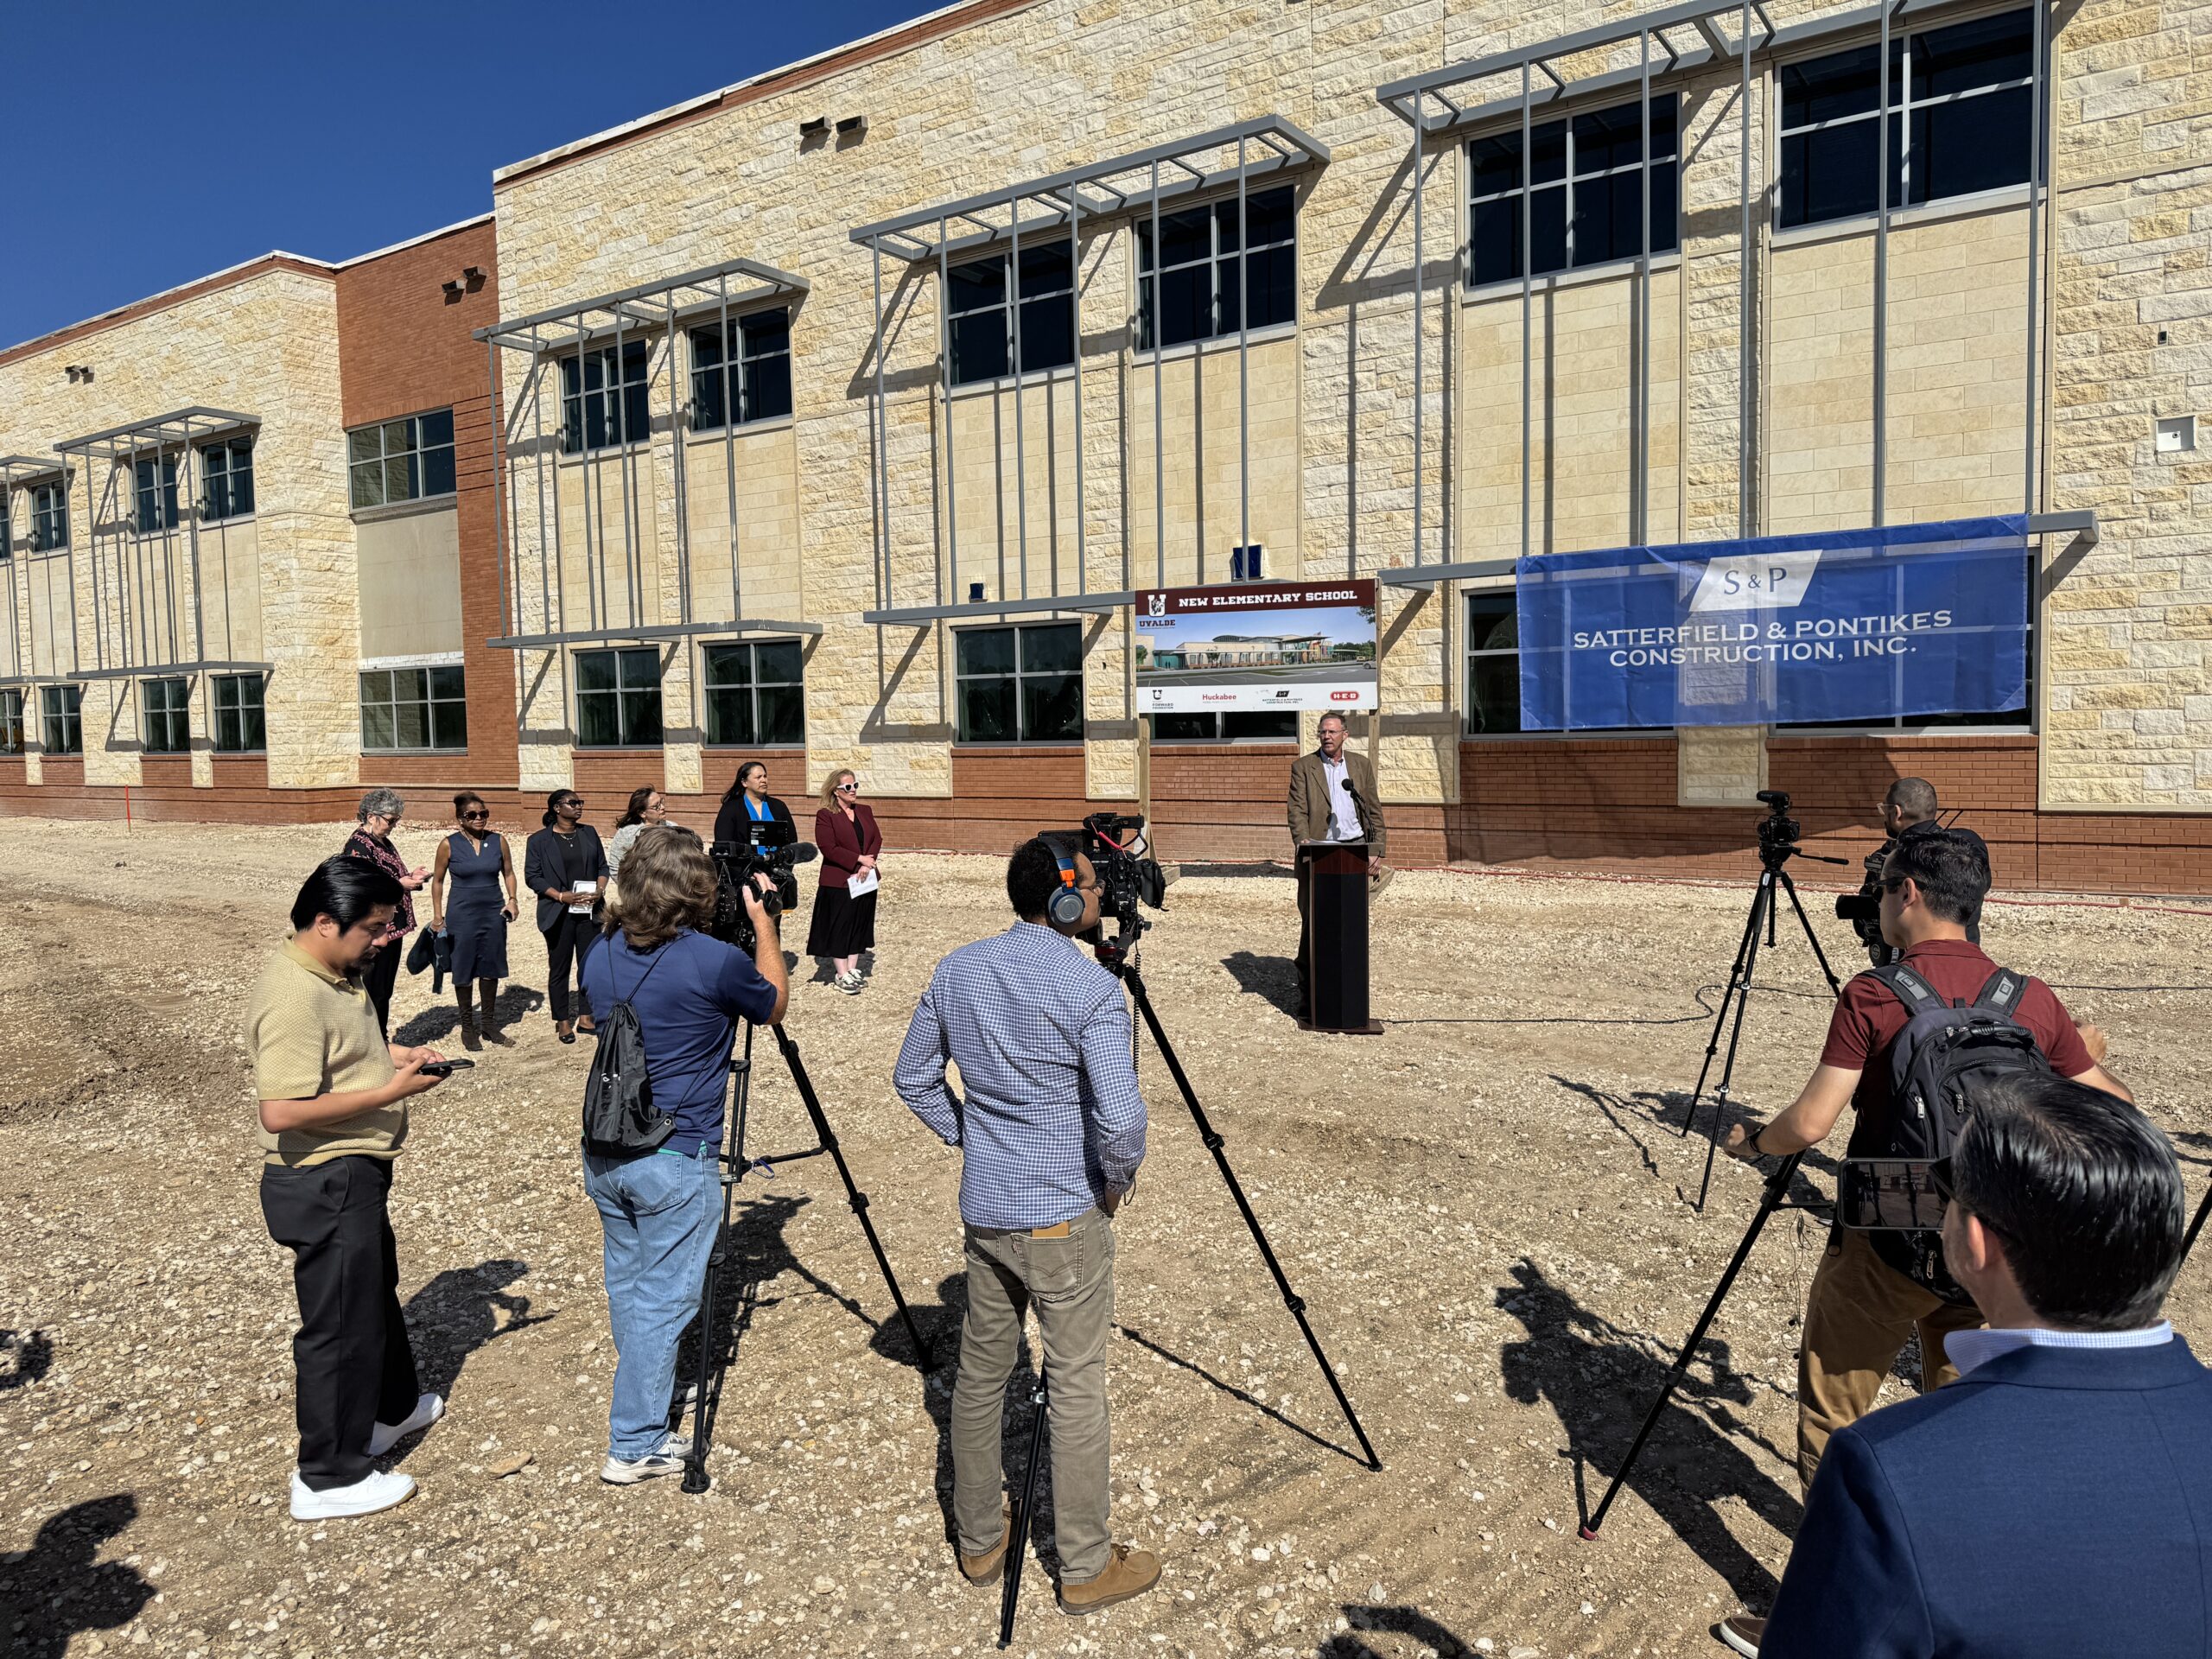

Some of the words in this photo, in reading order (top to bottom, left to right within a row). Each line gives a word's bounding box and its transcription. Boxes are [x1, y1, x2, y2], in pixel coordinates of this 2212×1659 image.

[1179, 597, 1208, 607] NEW
[1212, 593, 1301, 606] ELEMENTARY
[1306, 590, 1357, 601] SCHOOL
[1573, 622, 1758, 648] SATTERFIELD
[1767, 621, 1787, 639] &
[1795, 609, 1953, 639] PONTIKES
[1609, 641, 1844, 668] CONSTRUCTION,
[1853, 635, 1917, 658] INC.
